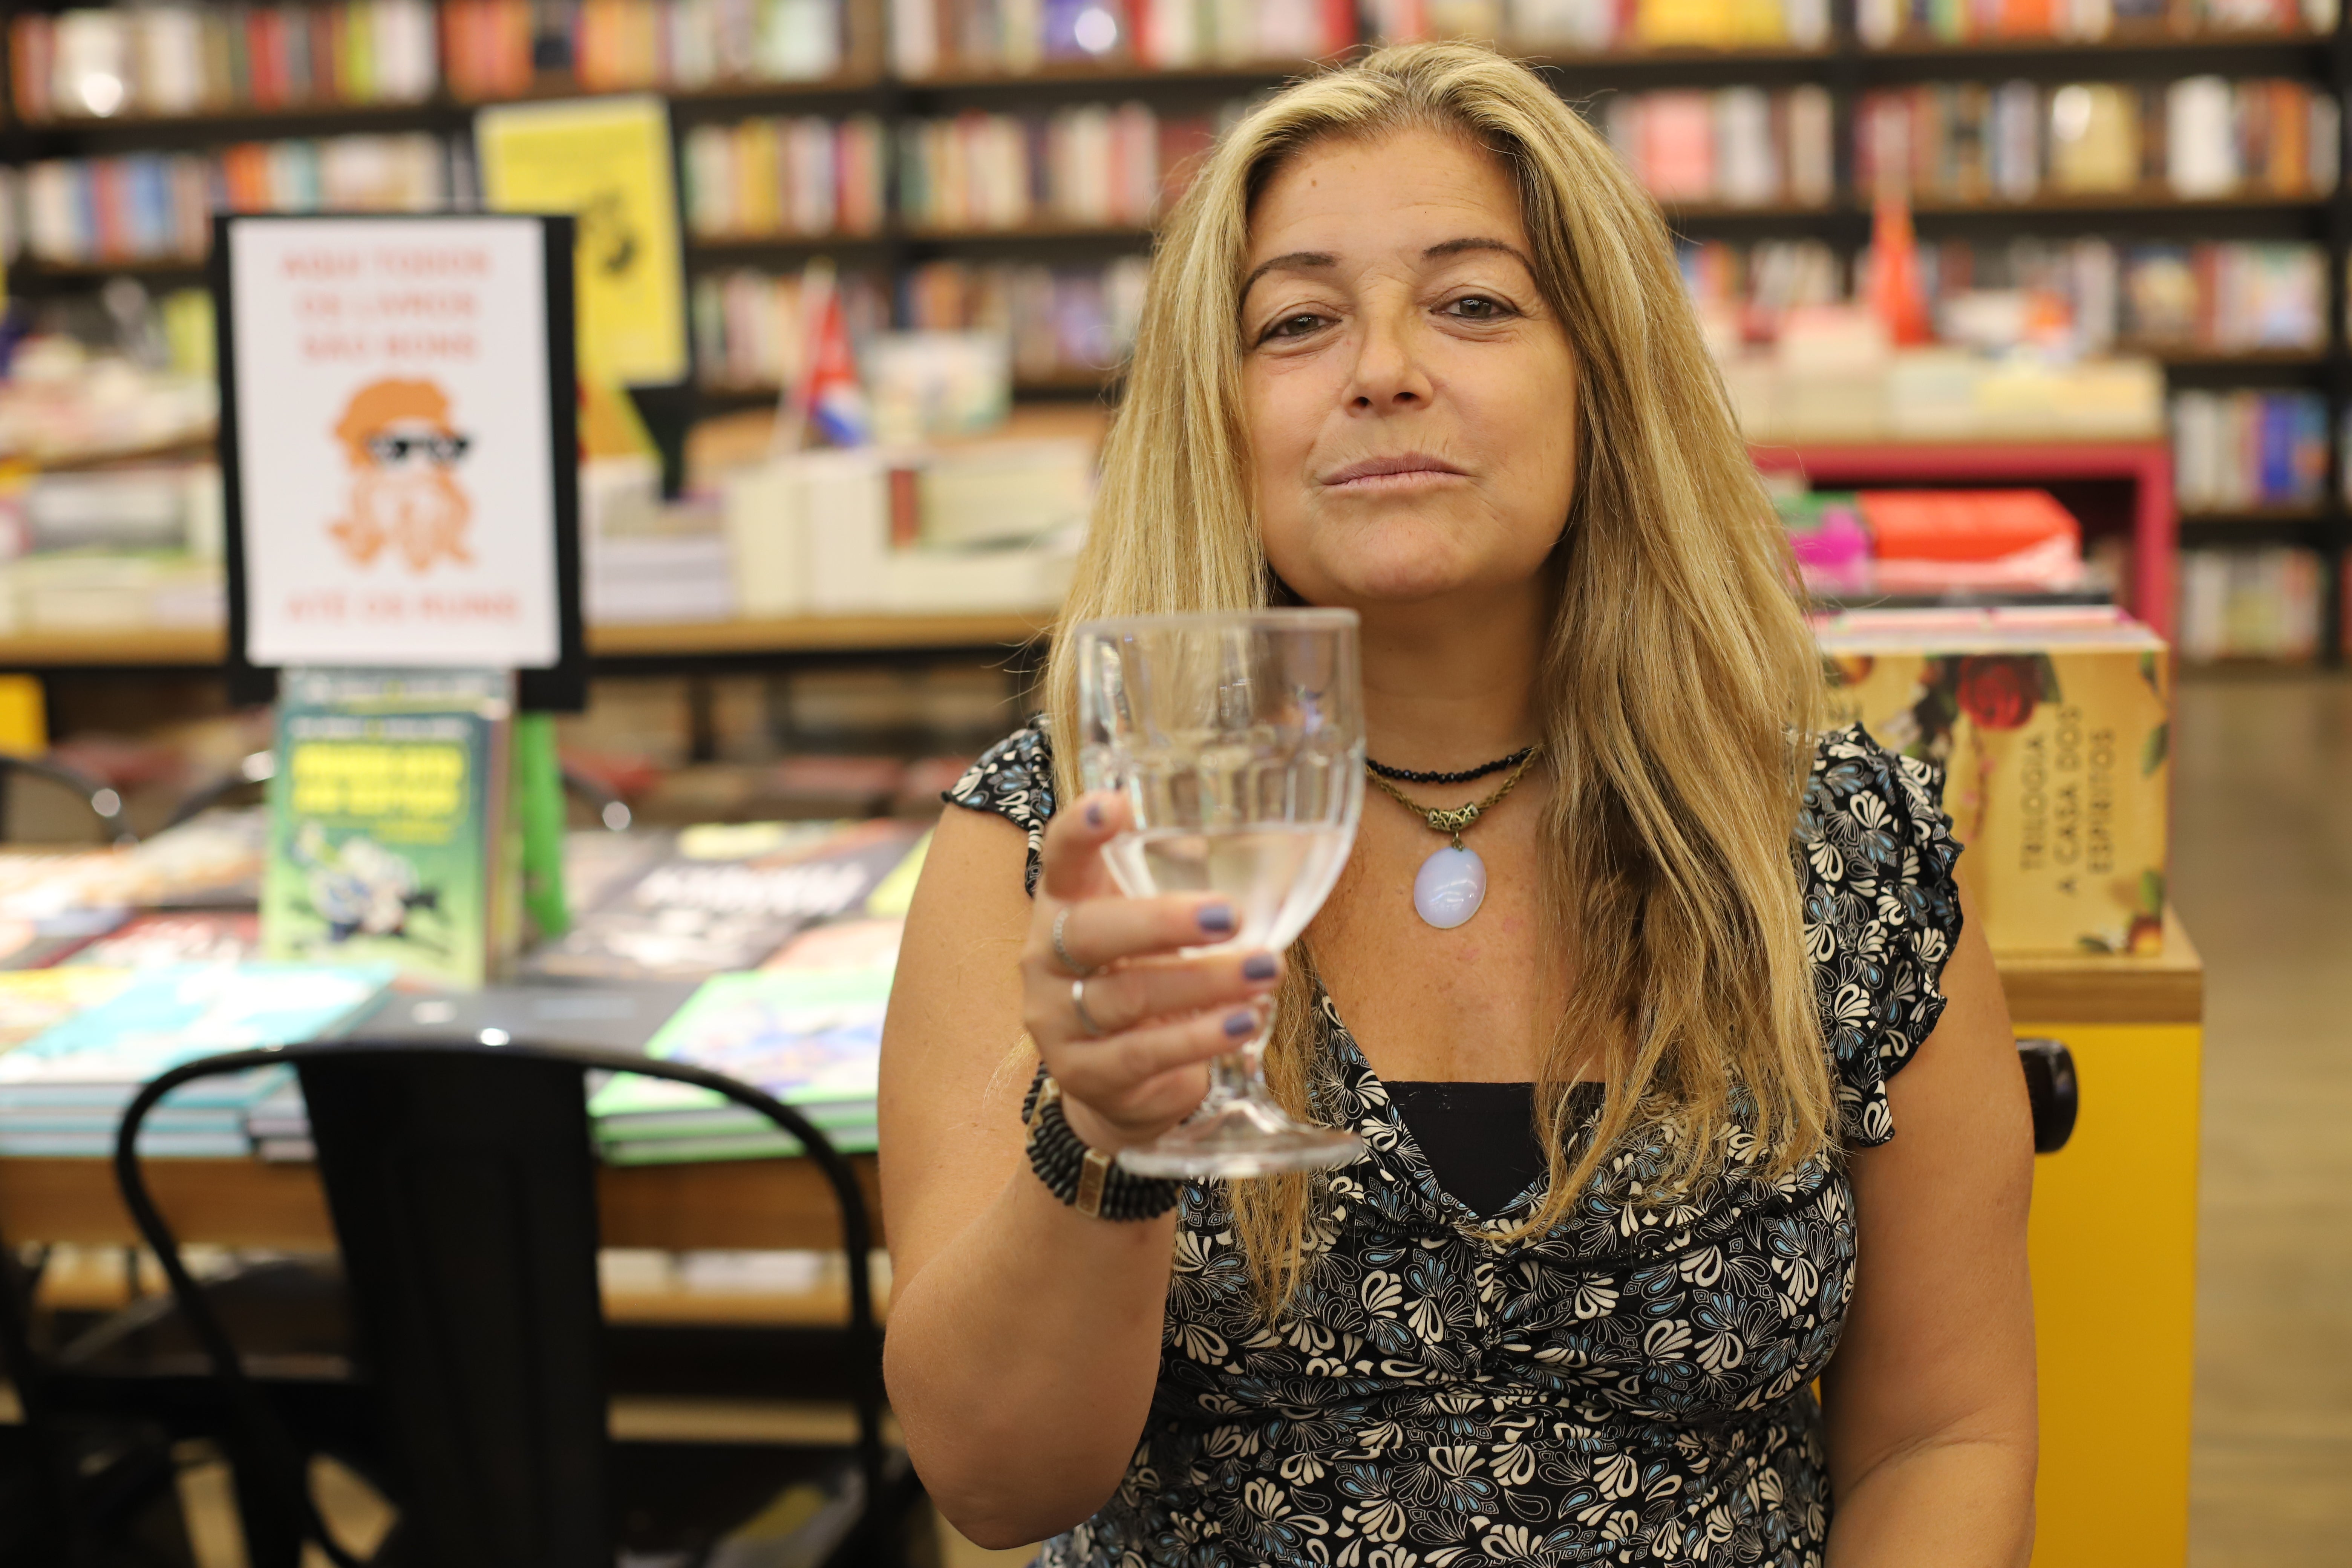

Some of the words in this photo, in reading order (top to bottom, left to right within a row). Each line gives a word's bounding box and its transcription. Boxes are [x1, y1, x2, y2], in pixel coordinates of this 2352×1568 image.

[2054, 704, 2083, 772] DOS
[2020, 732, 2049, 874] TRILOGIA
[2054, 783, 2082, 867] CASA
[2056, 873, 2080, 899] A
